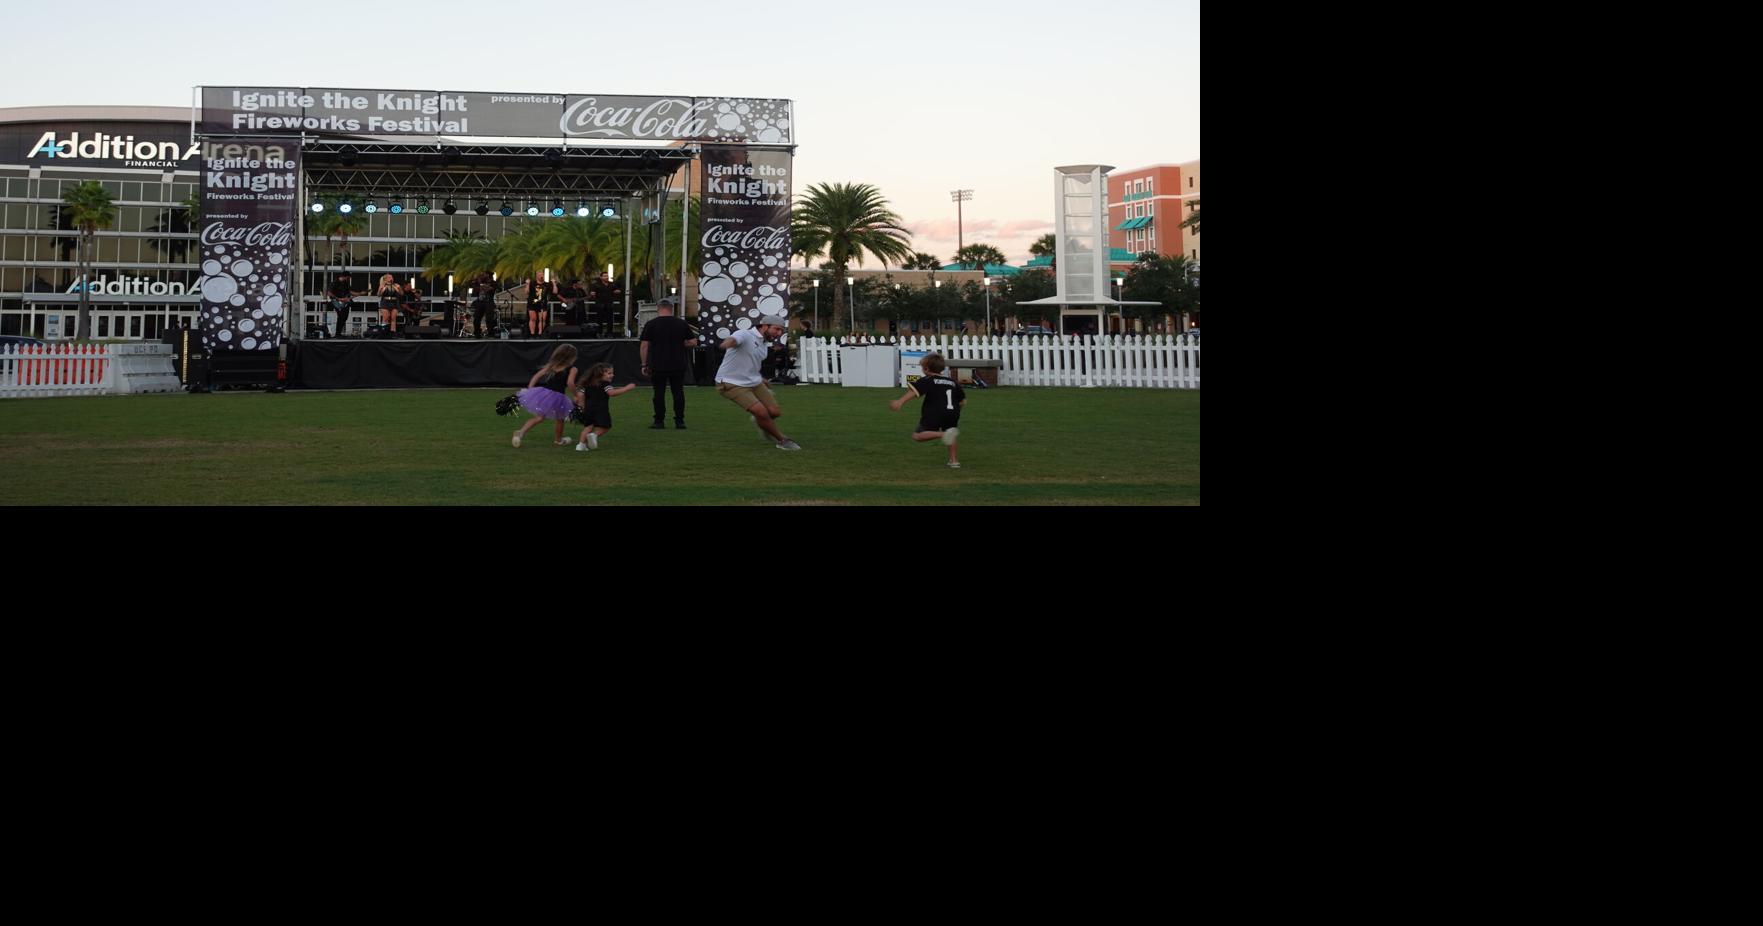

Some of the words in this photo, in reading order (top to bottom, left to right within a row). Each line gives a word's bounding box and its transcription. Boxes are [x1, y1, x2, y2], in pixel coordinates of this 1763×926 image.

[232, 90, 314, 110] Ignite
[322, 92, 369, 110] the
[377, 94, 467, 114] Knight
[491, 94, 548, 103] presented
[552, 95, 566, 104] by
[232, 114, 360, 131] Fireworks
[368, 117, 467, 133] Festival
[560, 97, 715, 138] Coca-Cola
[28, 131, 180, 160] Addition
[207, 156, 260, 171] Ignite
[265, 157, 296, 170] the
[707, 164, 755, 177] Ignite
[759, 165, 787, 177] the
[207, 172, 296, 192] Knight
[708, 178, 786, 197] Knight
[200, 221, 294, 246] Coca-Cola
[702, 225, 789, 249] Coca-Cola
[65, 275, 185, 296] Addition
[946, 389, 953, 409] 1
